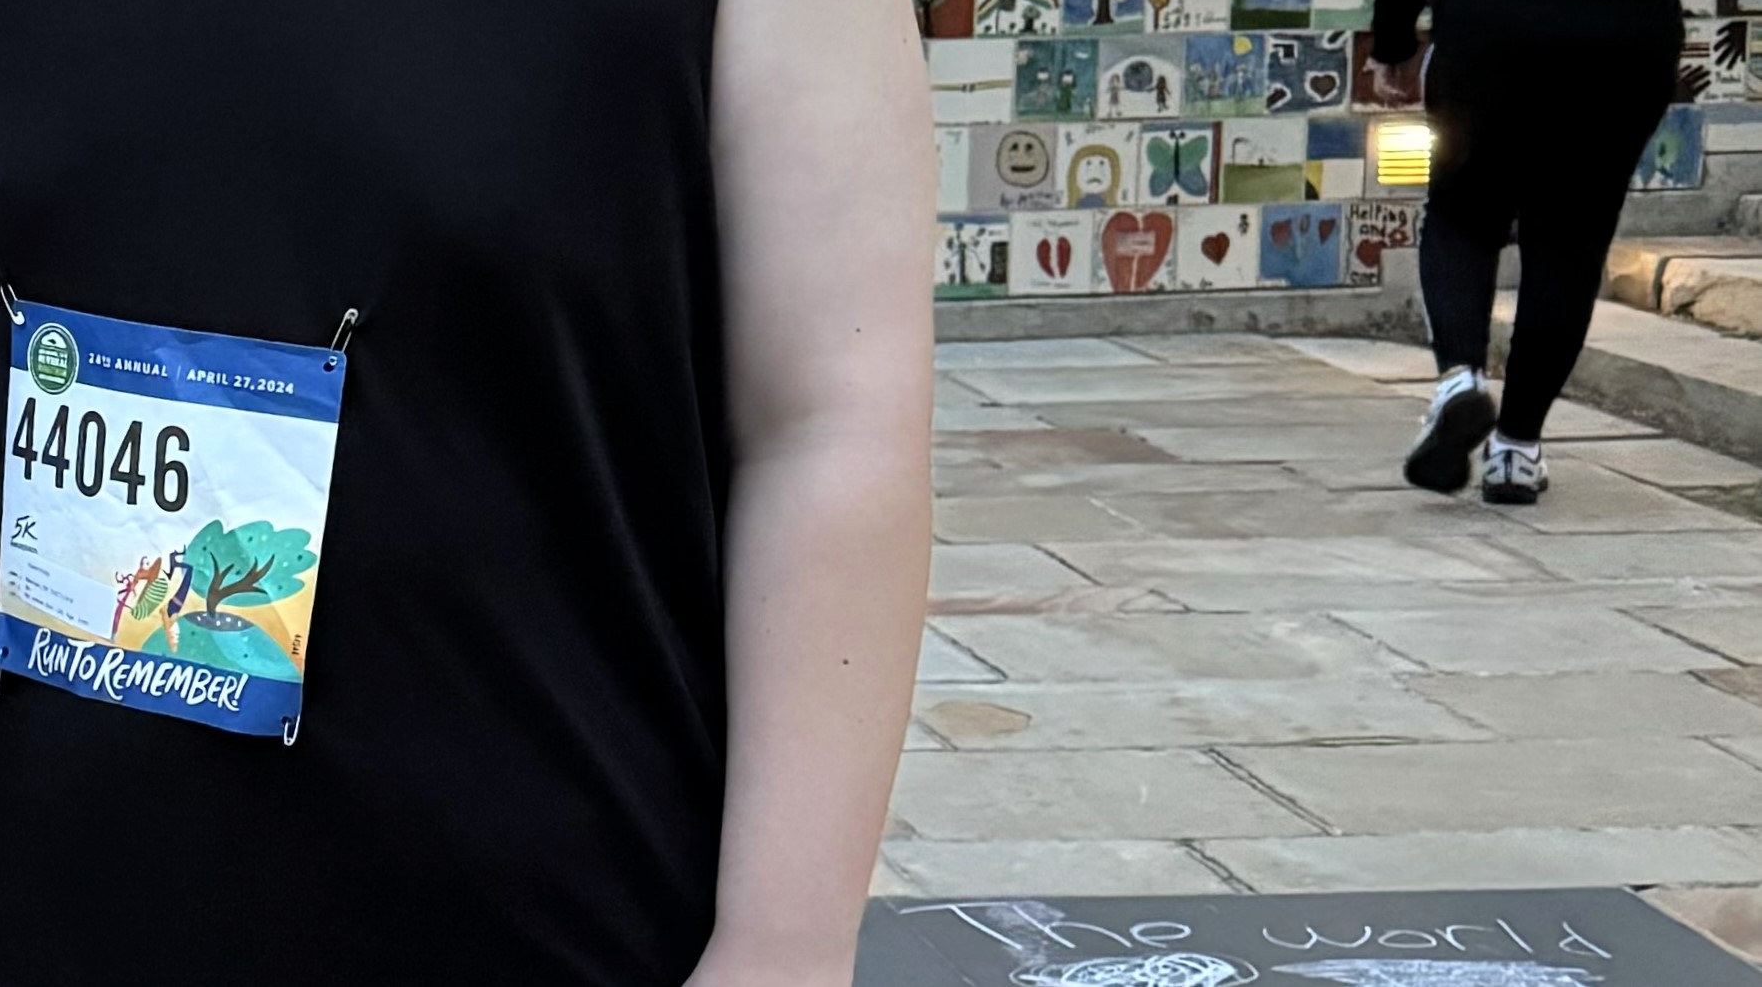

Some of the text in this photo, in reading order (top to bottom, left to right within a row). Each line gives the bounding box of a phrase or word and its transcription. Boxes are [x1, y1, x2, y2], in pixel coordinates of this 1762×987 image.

[114, 357, 169, 377] ANNUAL
[186, 368, 229, 385] APRIL
[12, 396, 191, 512] 44046
[11, 515, 38, 541] 5K
[899, 901, 1612, 959] The world
